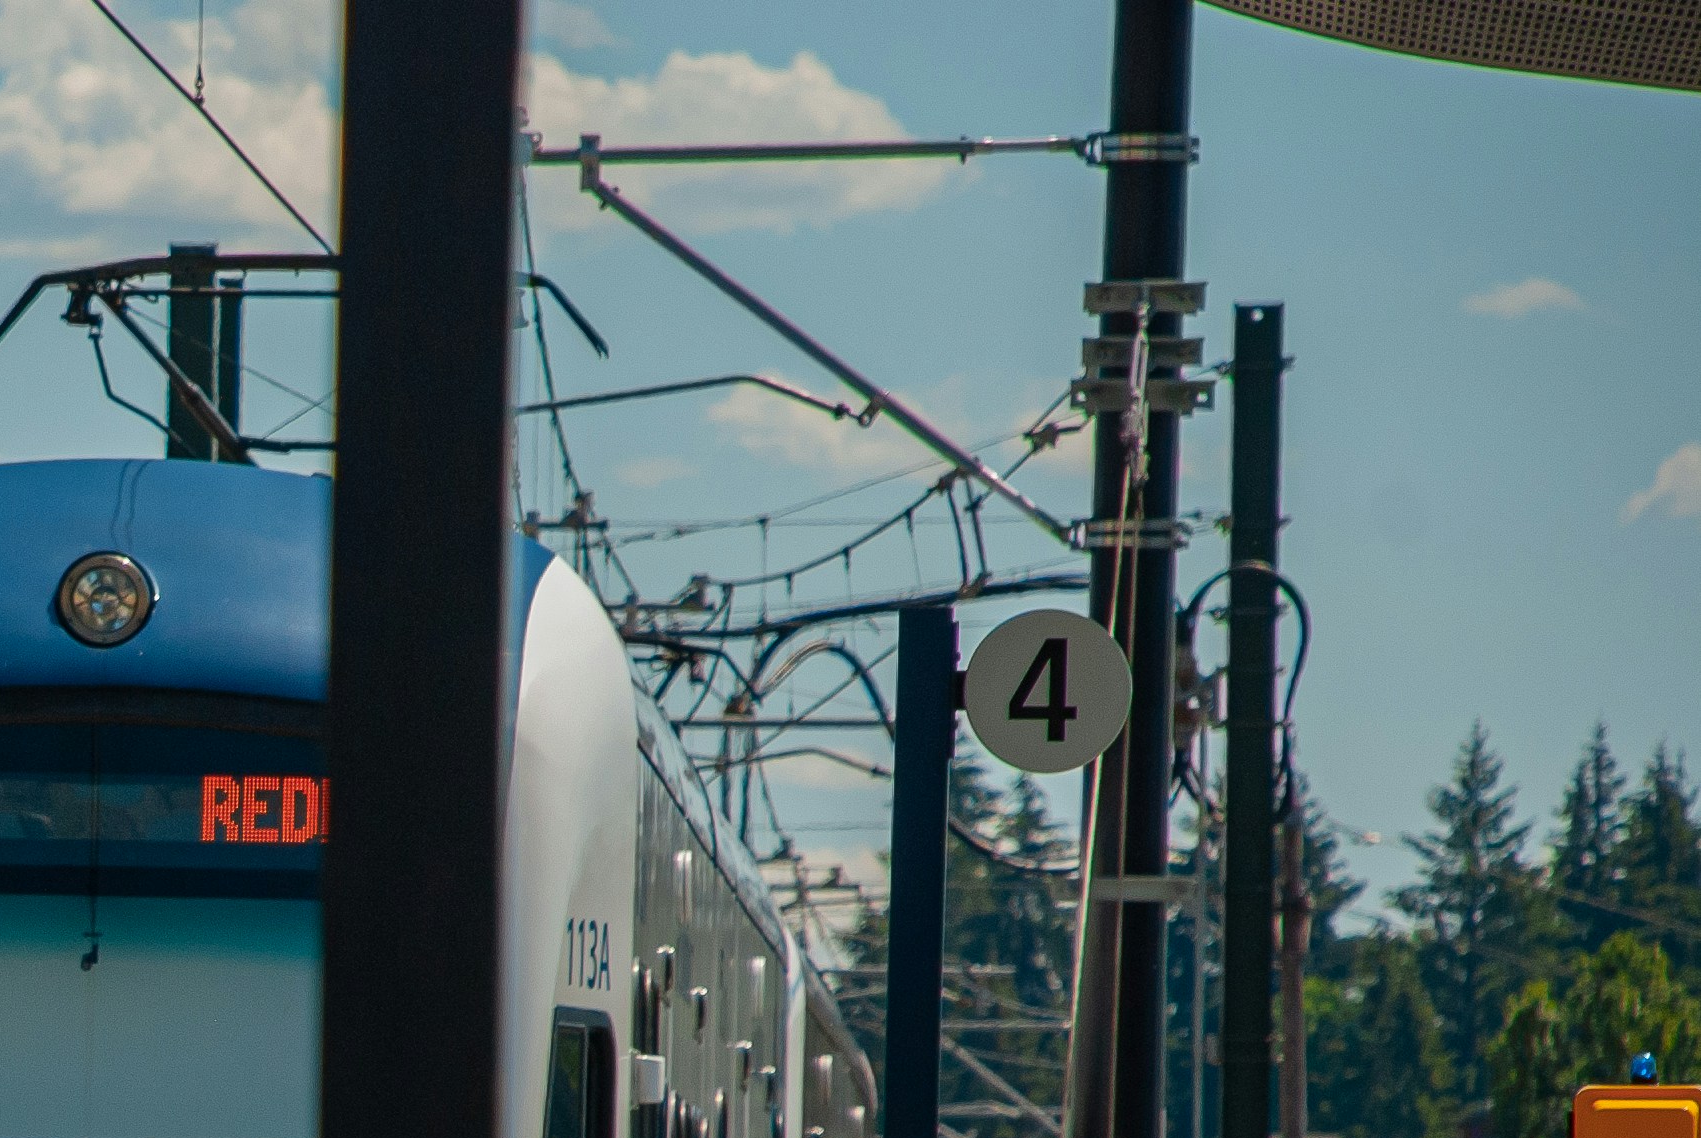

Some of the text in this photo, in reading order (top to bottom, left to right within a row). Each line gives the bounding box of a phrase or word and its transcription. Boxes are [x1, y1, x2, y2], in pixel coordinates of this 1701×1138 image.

[1008, 637, 1078, 742] 4
[201, 775, 330, 843] RED
[566, 917, 611, 991] 113A
